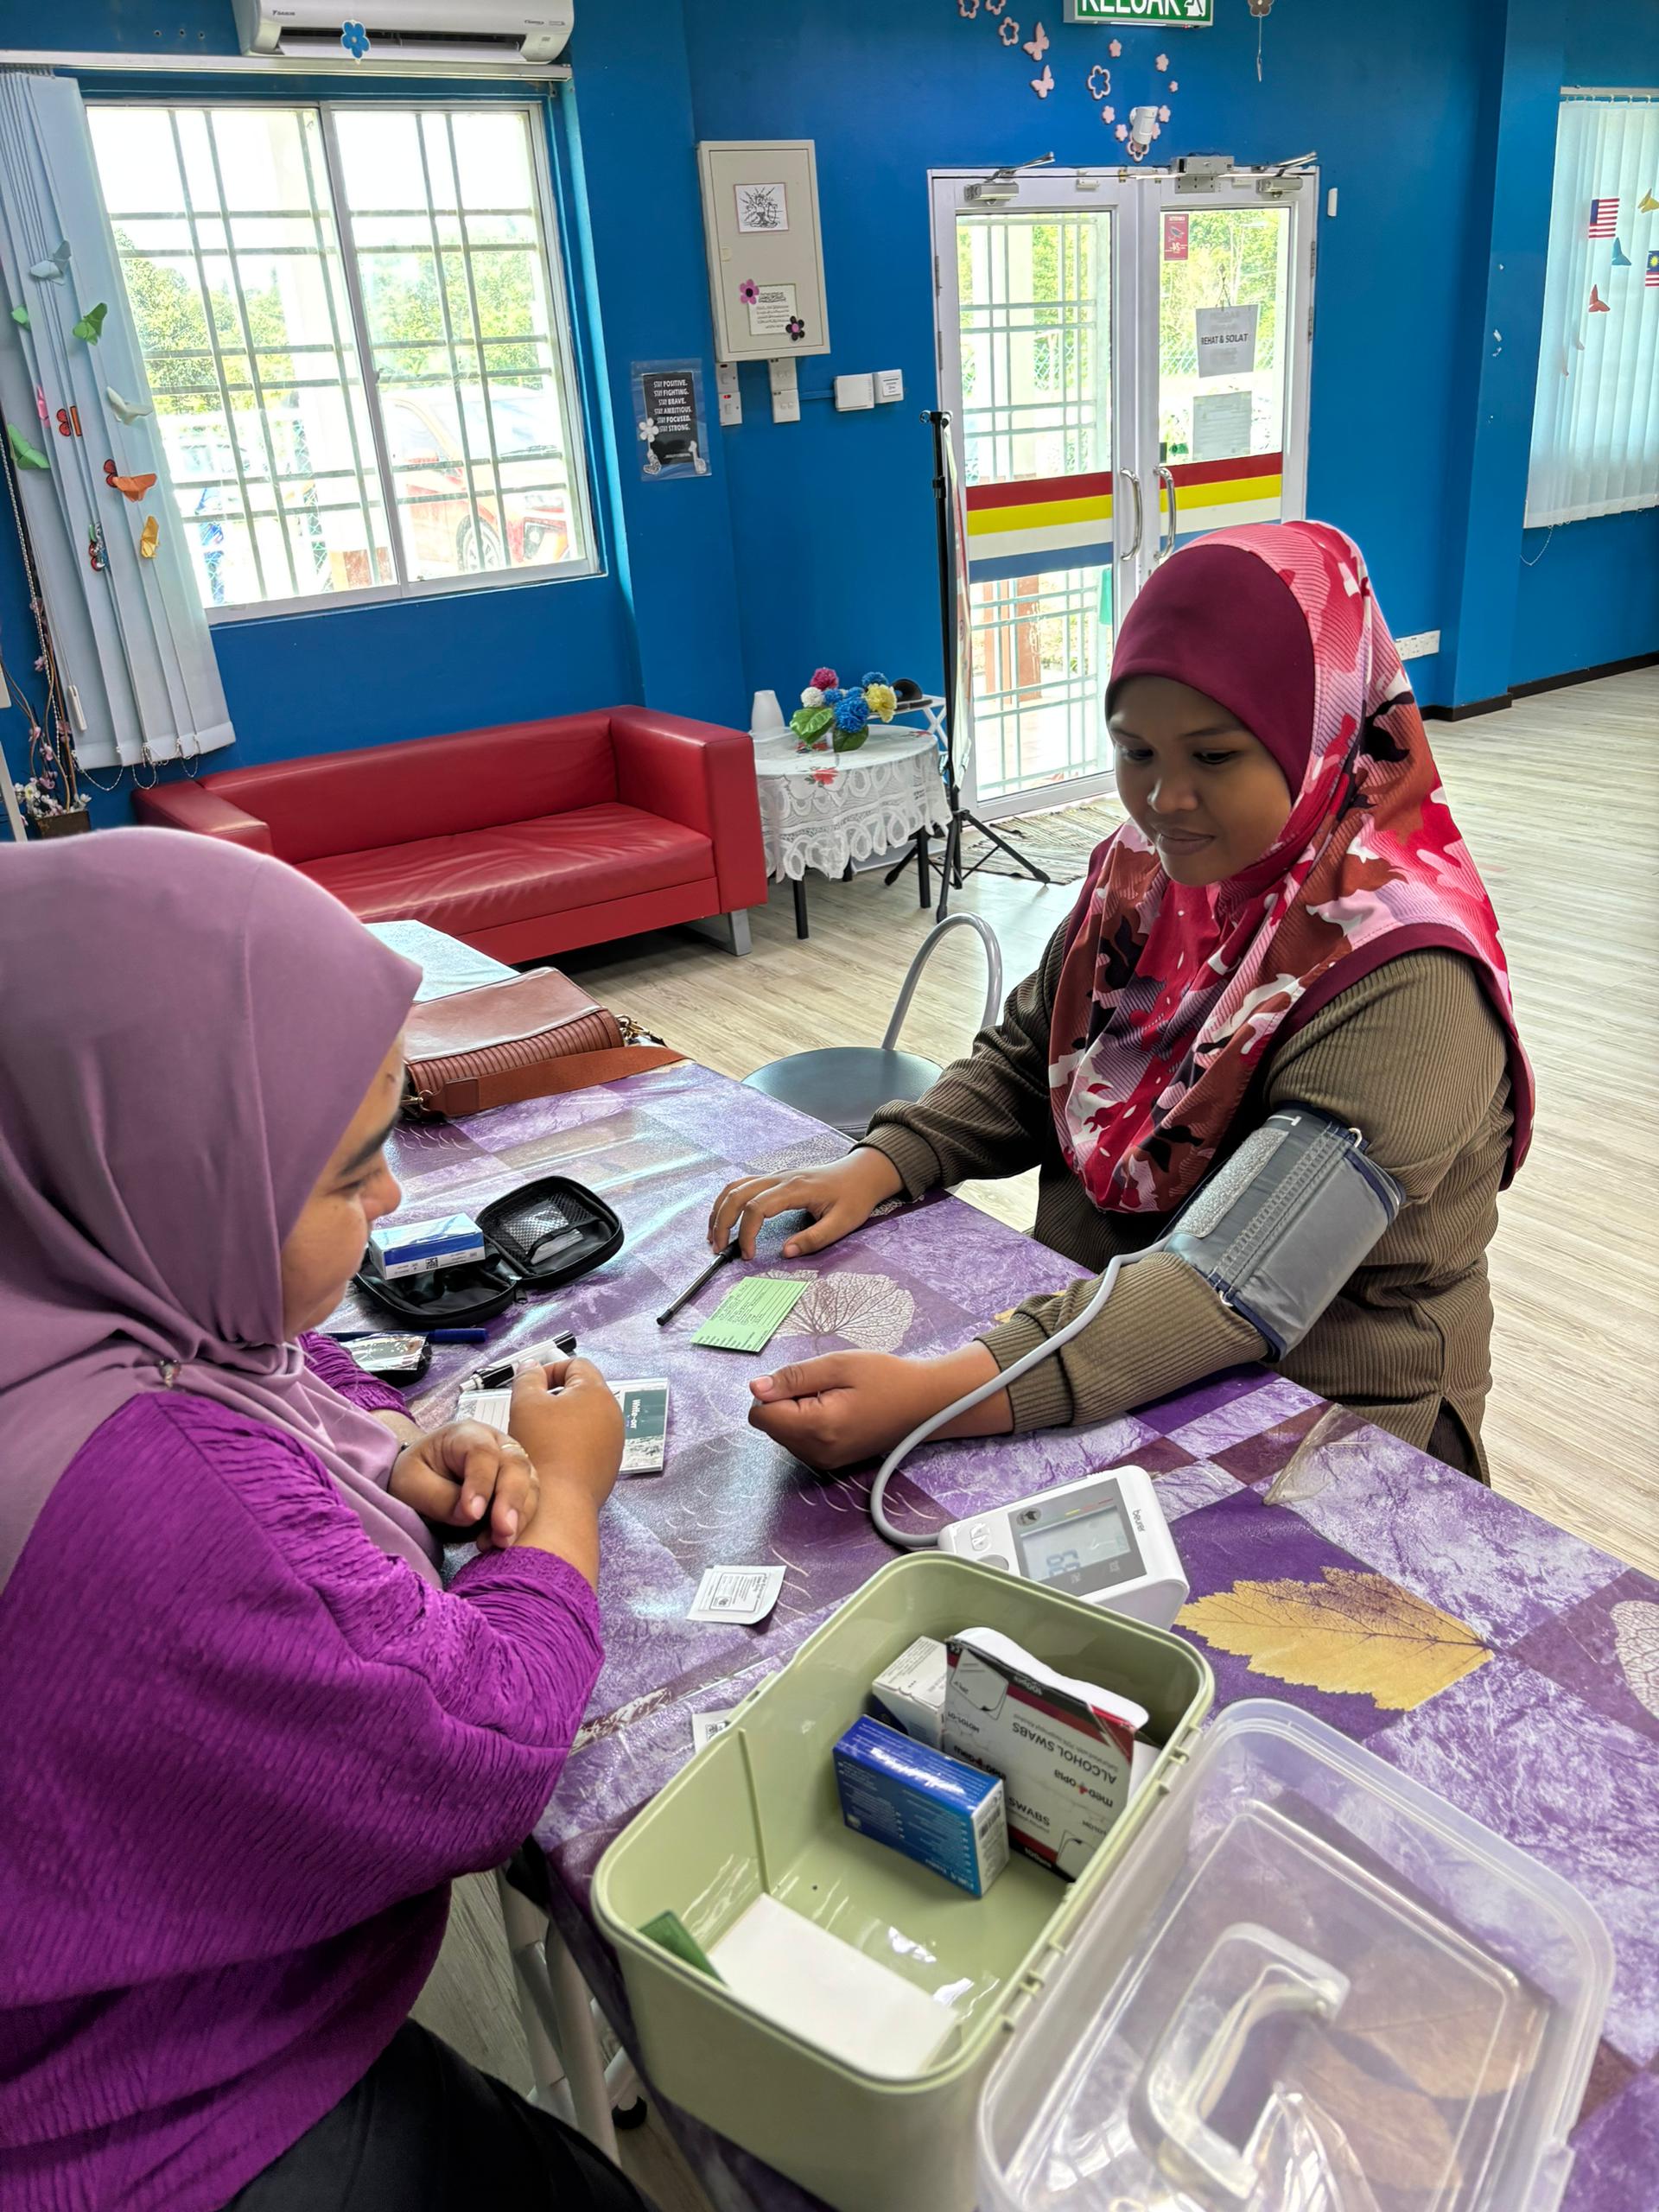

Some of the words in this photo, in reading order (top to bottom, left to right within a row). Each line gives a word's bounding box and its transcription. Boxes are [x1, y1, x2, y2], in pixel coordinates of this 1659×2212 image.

[1201, 335, 1218, 346] REHAT
[1219, 334, 1224, 344] &
[1225, 333, 1249, 343] SOLAT
[664, 379, 688, 388] POSITIVE.
[664, 388, 690, 397] FIGHTING.
[669, 423, 691, 432] STRONG.
[1133, 1509, 1146, 1532] beurer
[1012, 1721, 1055, 1752] SWABS
[1057, 1745, 1117, 1785] ALCOHOL
[1008, 1797, 1050, 1827] SWABS
